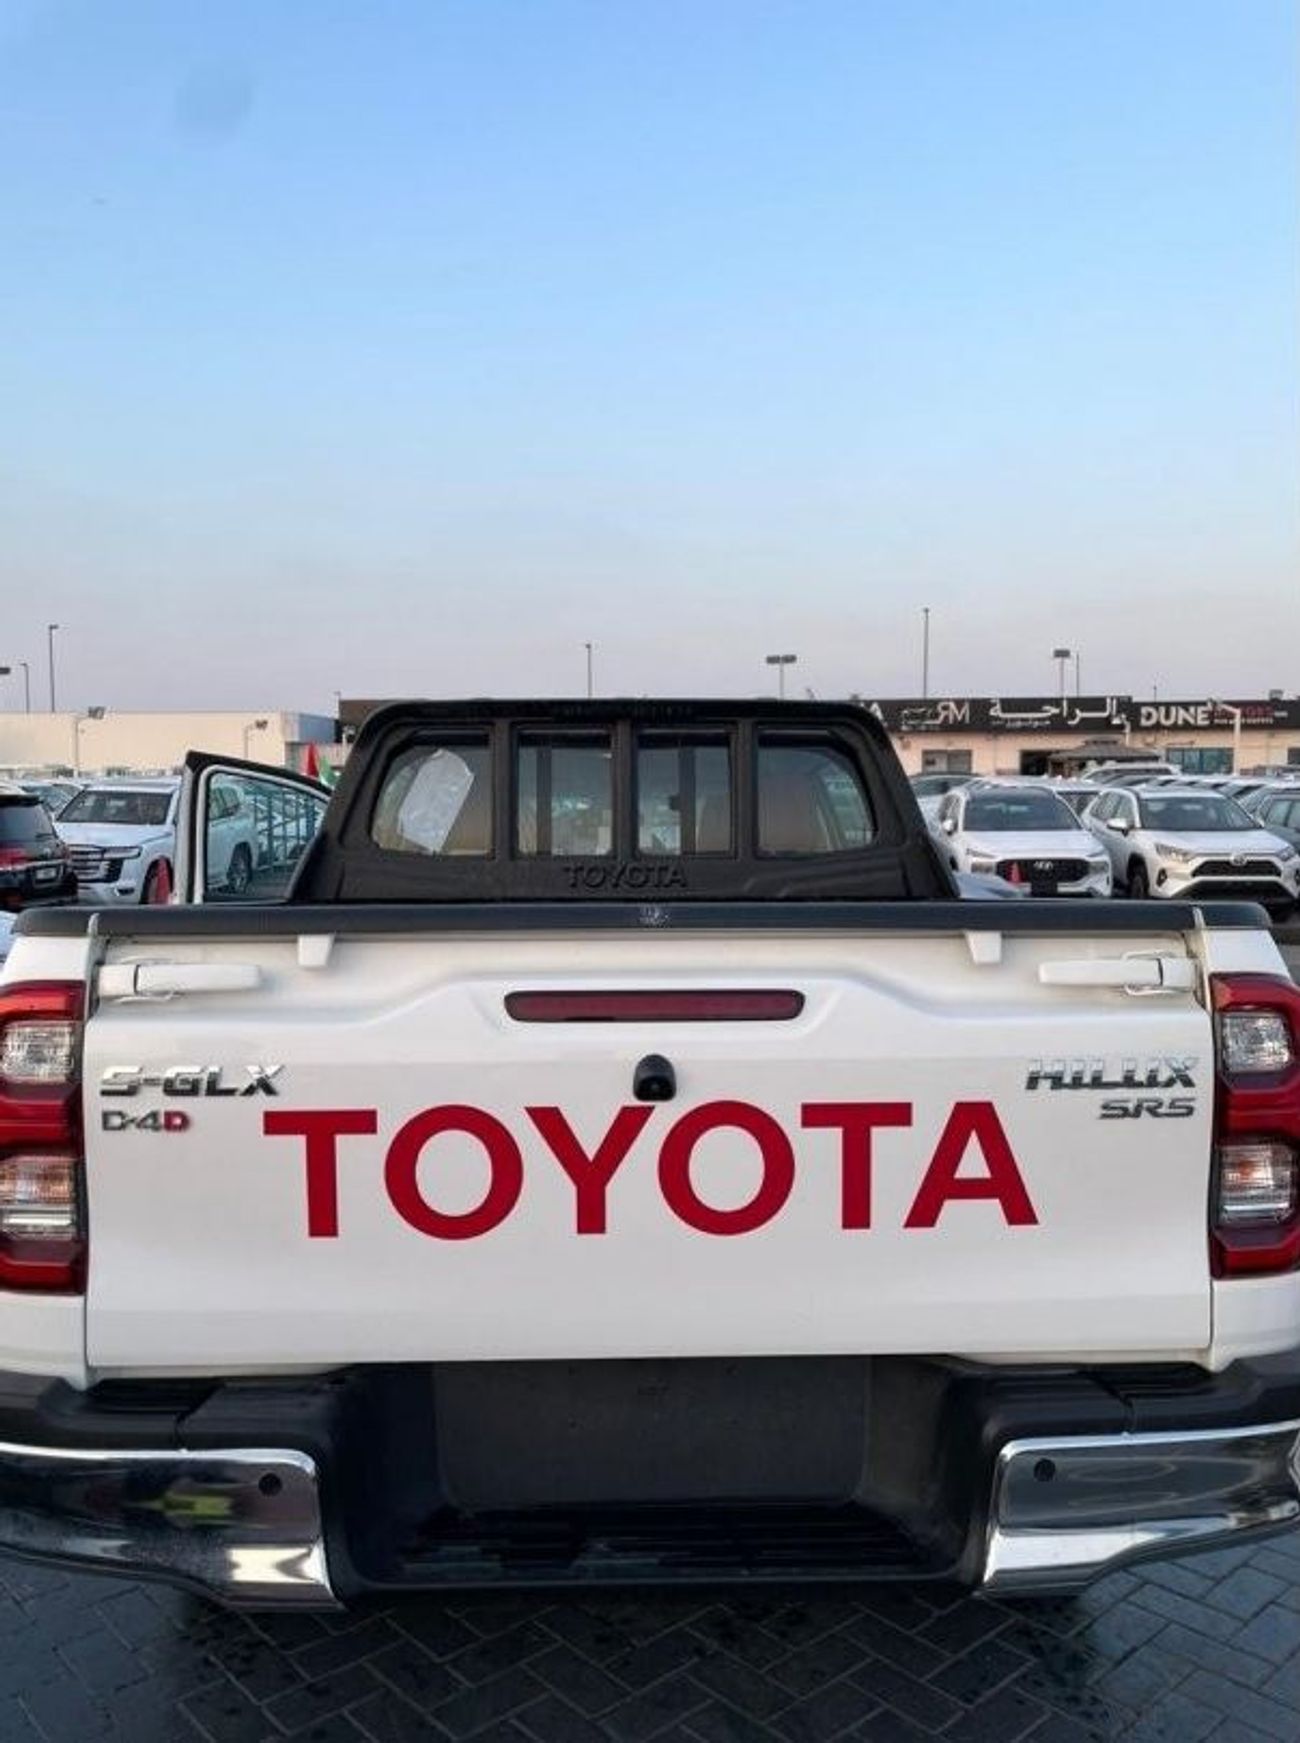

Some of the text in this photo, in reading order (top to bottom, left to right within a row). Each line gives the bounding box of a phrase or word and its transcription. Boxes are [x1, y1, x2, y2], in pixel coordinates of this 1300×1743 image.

[1139, 705, 1210, 726] DUNE
[564, 862, 688, 889] TOYOTA
[100, 1064, 286, 1096] S-GLX
[1025, 1058, 1197, 1090] HILUX
[101, 1109, 191, 1132] D-4D
[263, 1101, 1038, 1240] TOYOTA
